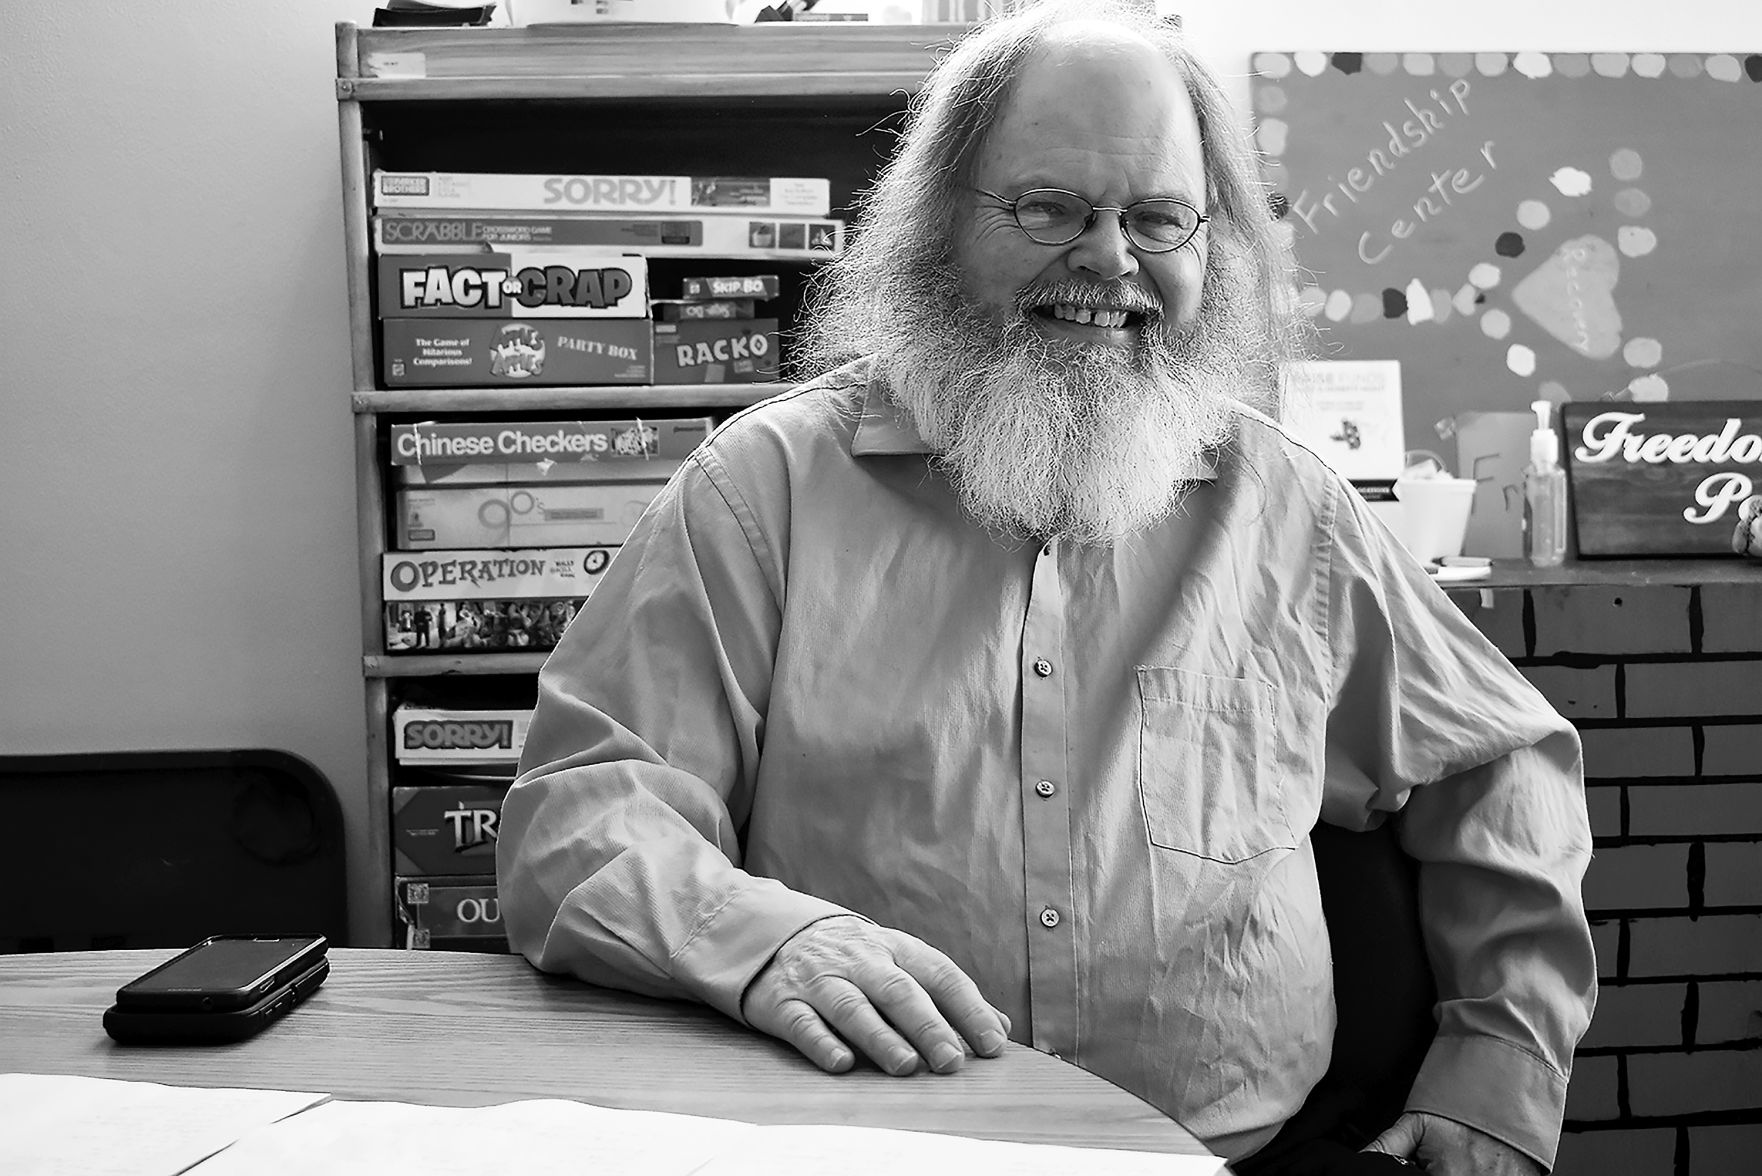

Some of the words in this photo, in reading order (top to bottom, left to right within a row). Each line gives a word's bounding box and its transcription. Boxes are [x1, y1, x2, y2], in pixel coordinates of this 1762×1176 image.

[1293, 78, 1471, 234] Friendship
[543, 177, 677, 206] SORRY!
[1357, 140, 1497, 265] Center
[385, 221, 483, 241] SCRABBLE
[531, 225, 552, 234] GAME
[401, 265, 508, 308] FACT
[502, 277, 523, 296] OR
[515, 265, 633, 308] CRAP
[415, 338, 432, 346] The
[433, 338, 459, 346] Game
[460, 338, 470, 346] of
[422, 348, 463, 356] Hilarious
[557, 335, 605, 355] PARTY
[608, 344, 638, 361] BOX
[413, 357, 473, 368] Comparisons!
[397, 430, 495, 456] Chinese
[497, 429, 609, 453] Checkers
[1574, 411, 1762, 464] Freedo
[390, 558, 546, 592] OPERATION
[404, 719, 514, 750] SORRY!
[443, 800, 499, 848] TR
[456, 897, 500, 923] OU
